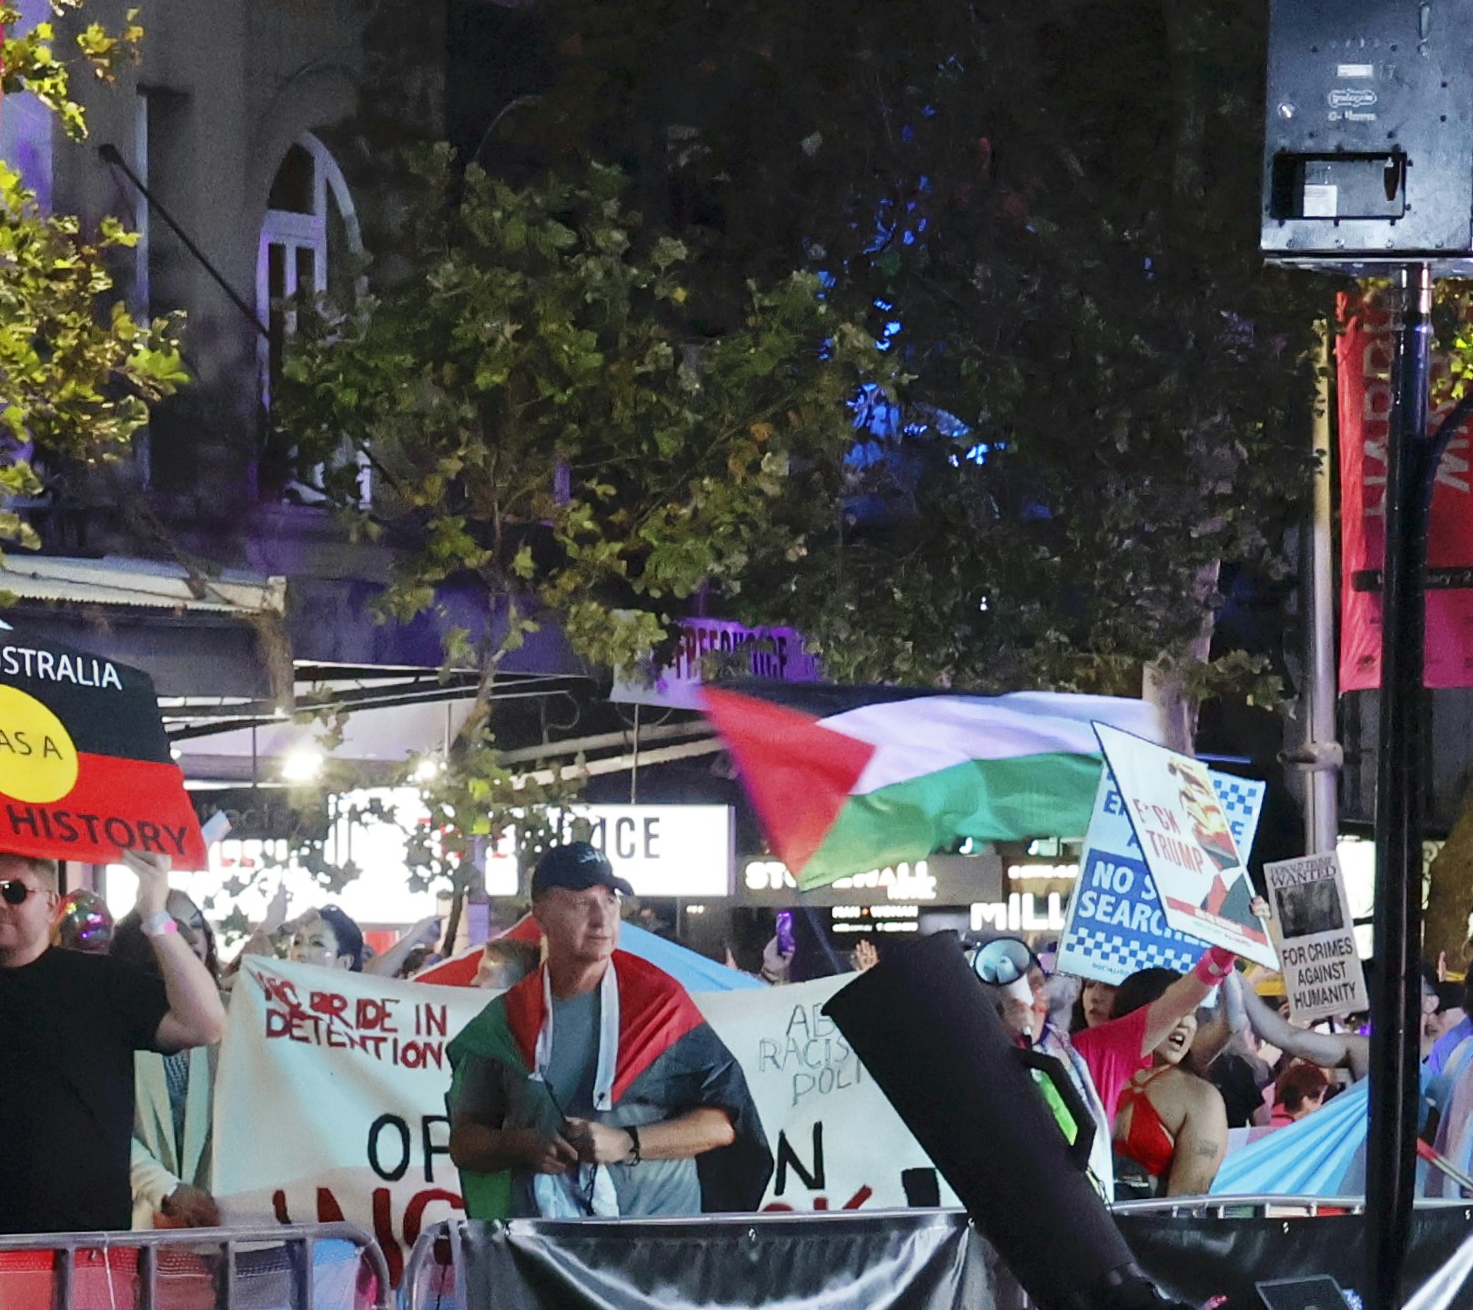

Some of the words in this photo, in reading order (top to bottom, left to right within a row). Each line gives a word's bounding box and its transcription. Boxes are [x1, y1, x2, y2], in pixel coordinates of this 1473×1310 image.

[42, 735, 64, 761] A
[5, 803, 189, 856] HISTORY
[1145, 829, 1204, 875] TRUMP
[1091, 860, 1135, 894] NO
[1270, 865, 1338, 889] WANTED
[1282, 945, 1309, 968] FOR
[1308, 936, 1354, 962] CRIMES
[1297, 960, 1347, 987] AGAINST
[1293, 981, 1357, 1010] HUMANITY
[309, 990, 401, 1031] PRIDE
[414, 1002, 447, 1037] IN
[265, 1007, 444, 1071] DETENTION
